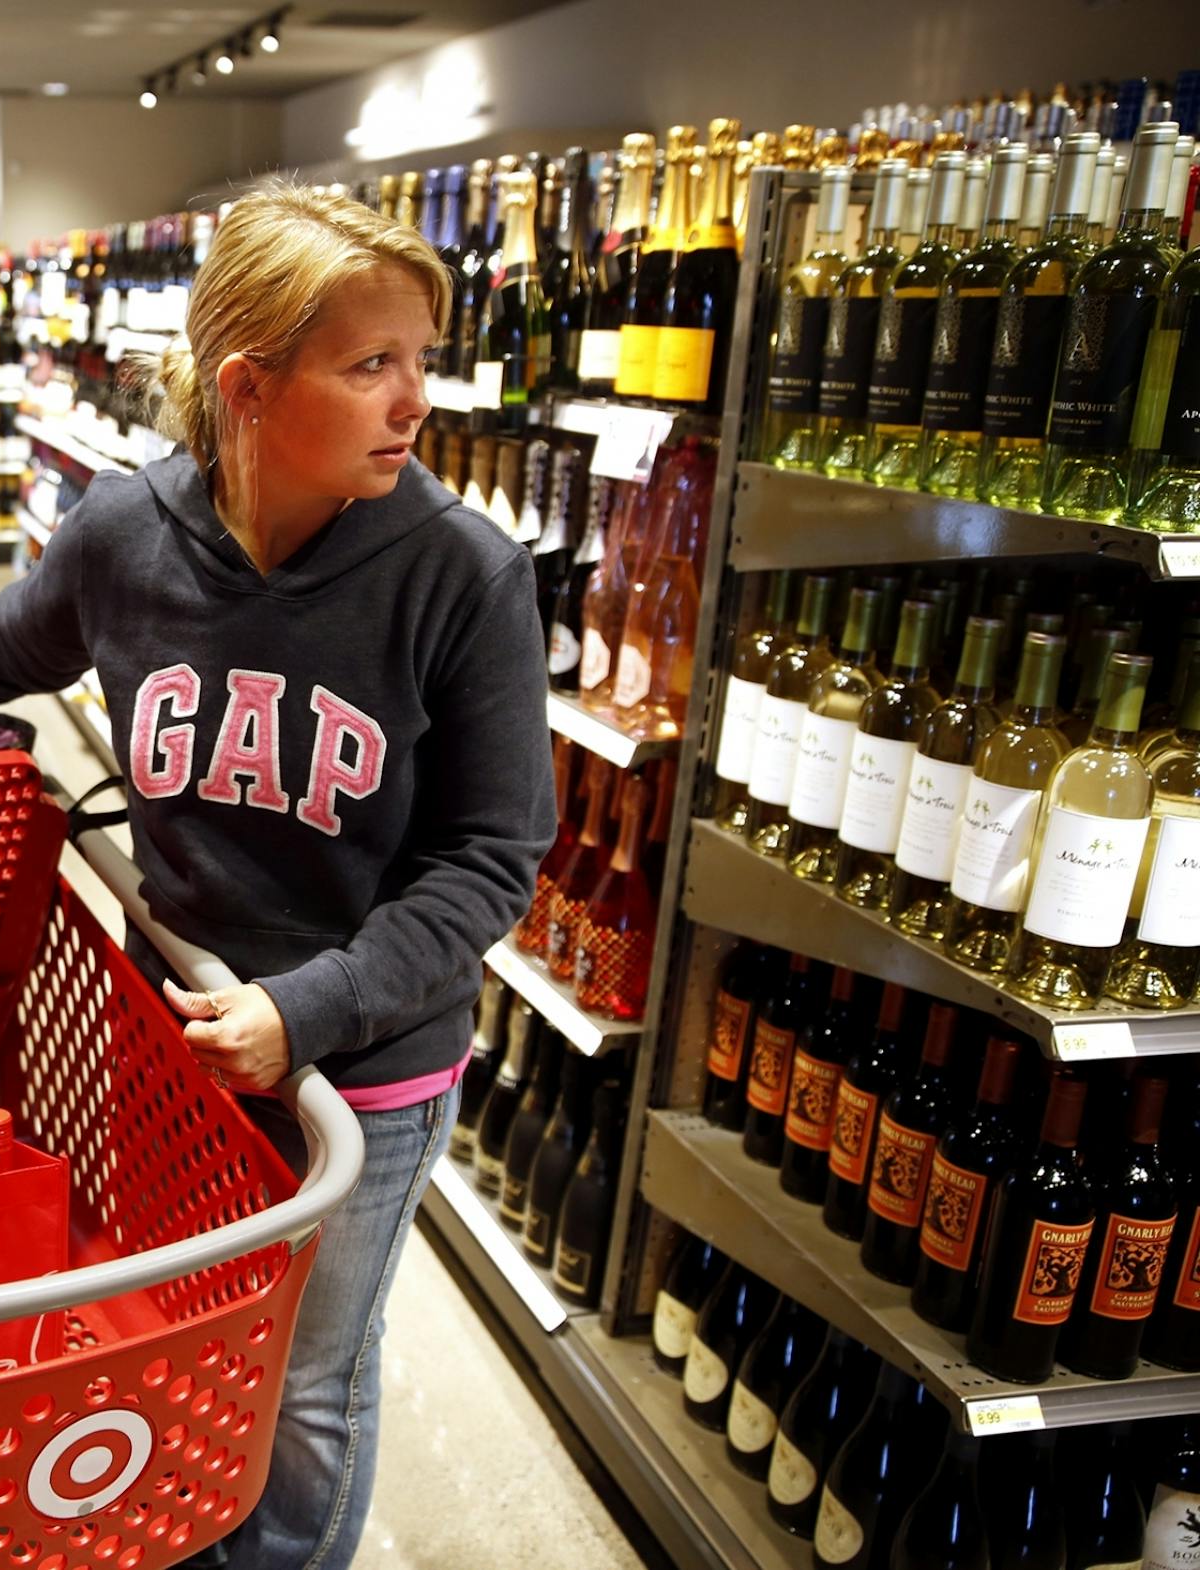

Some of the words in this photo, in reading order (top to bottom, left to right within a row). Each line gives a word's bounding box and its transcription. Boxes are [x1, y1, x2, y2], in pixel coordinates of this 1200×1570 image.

[1077, 402, 1117, 414] WHITE
[130, 663, 388, 838] GAP
[950, 1174, 977, 1192] HEAD
[1042, 1229, 1082, 1244] GNARLY
[1117, 1223, 1160, 1240] GNARLY
